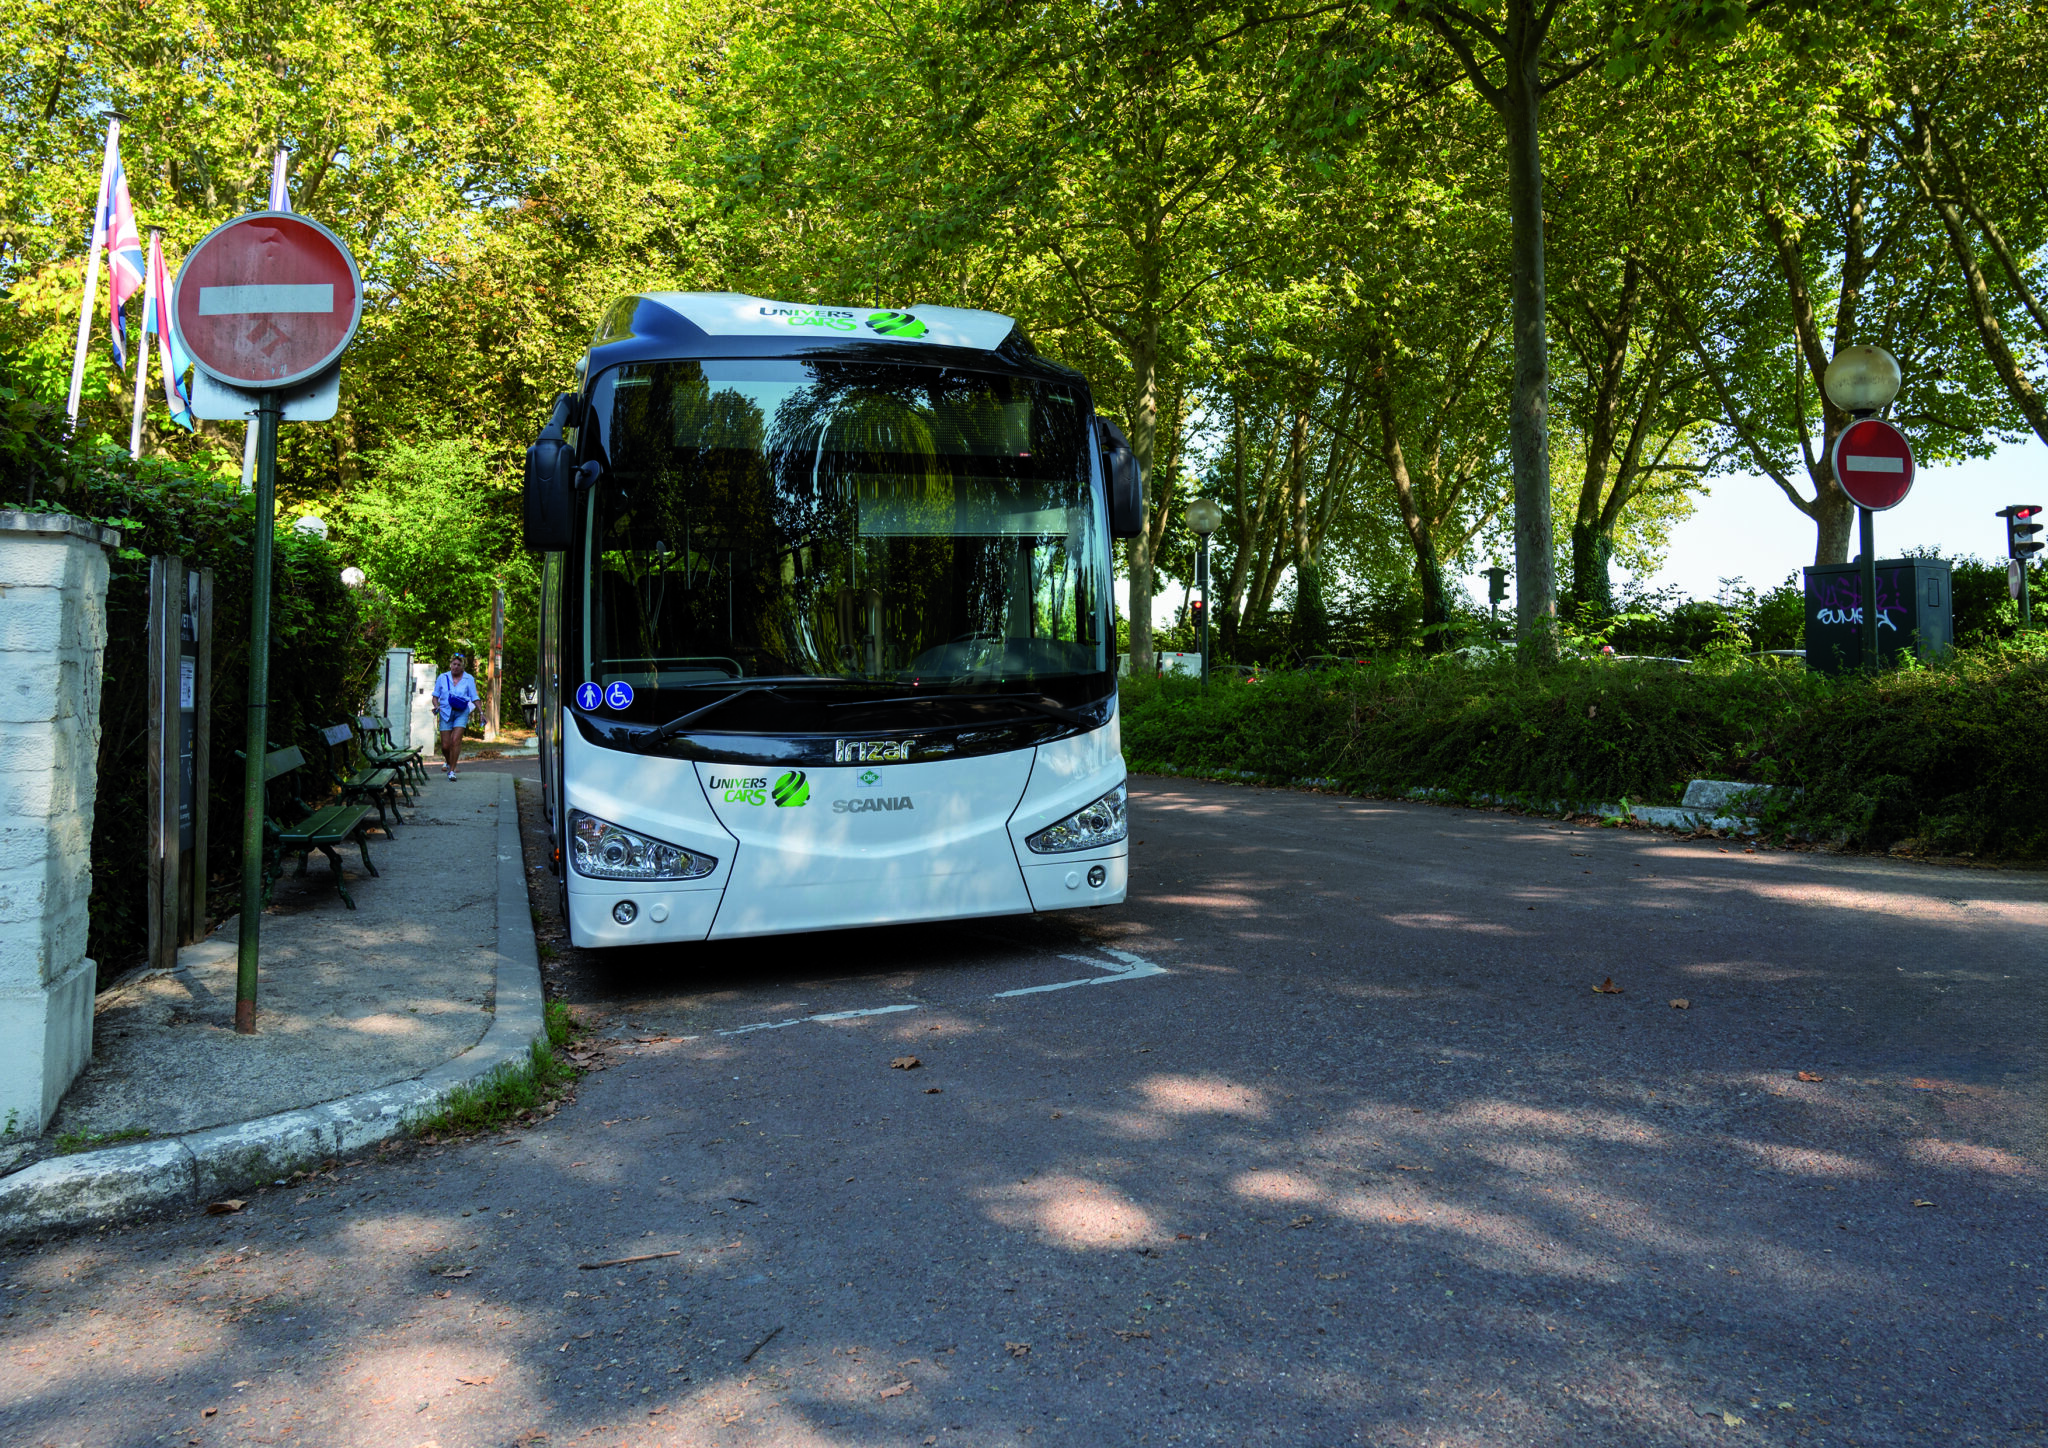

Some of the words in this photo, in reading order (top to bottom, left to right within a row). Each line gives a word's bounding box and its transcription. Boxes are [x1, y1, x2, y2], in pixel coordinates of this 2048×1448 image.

[759, 307, 854, 318] UNIVERS
[787, 316, 858, 331] CARS
[709, 775, 768, 789] UNIVERS
[724, 788, 768, 807] CARS
[832, 796, 915, 814] SCANIA
